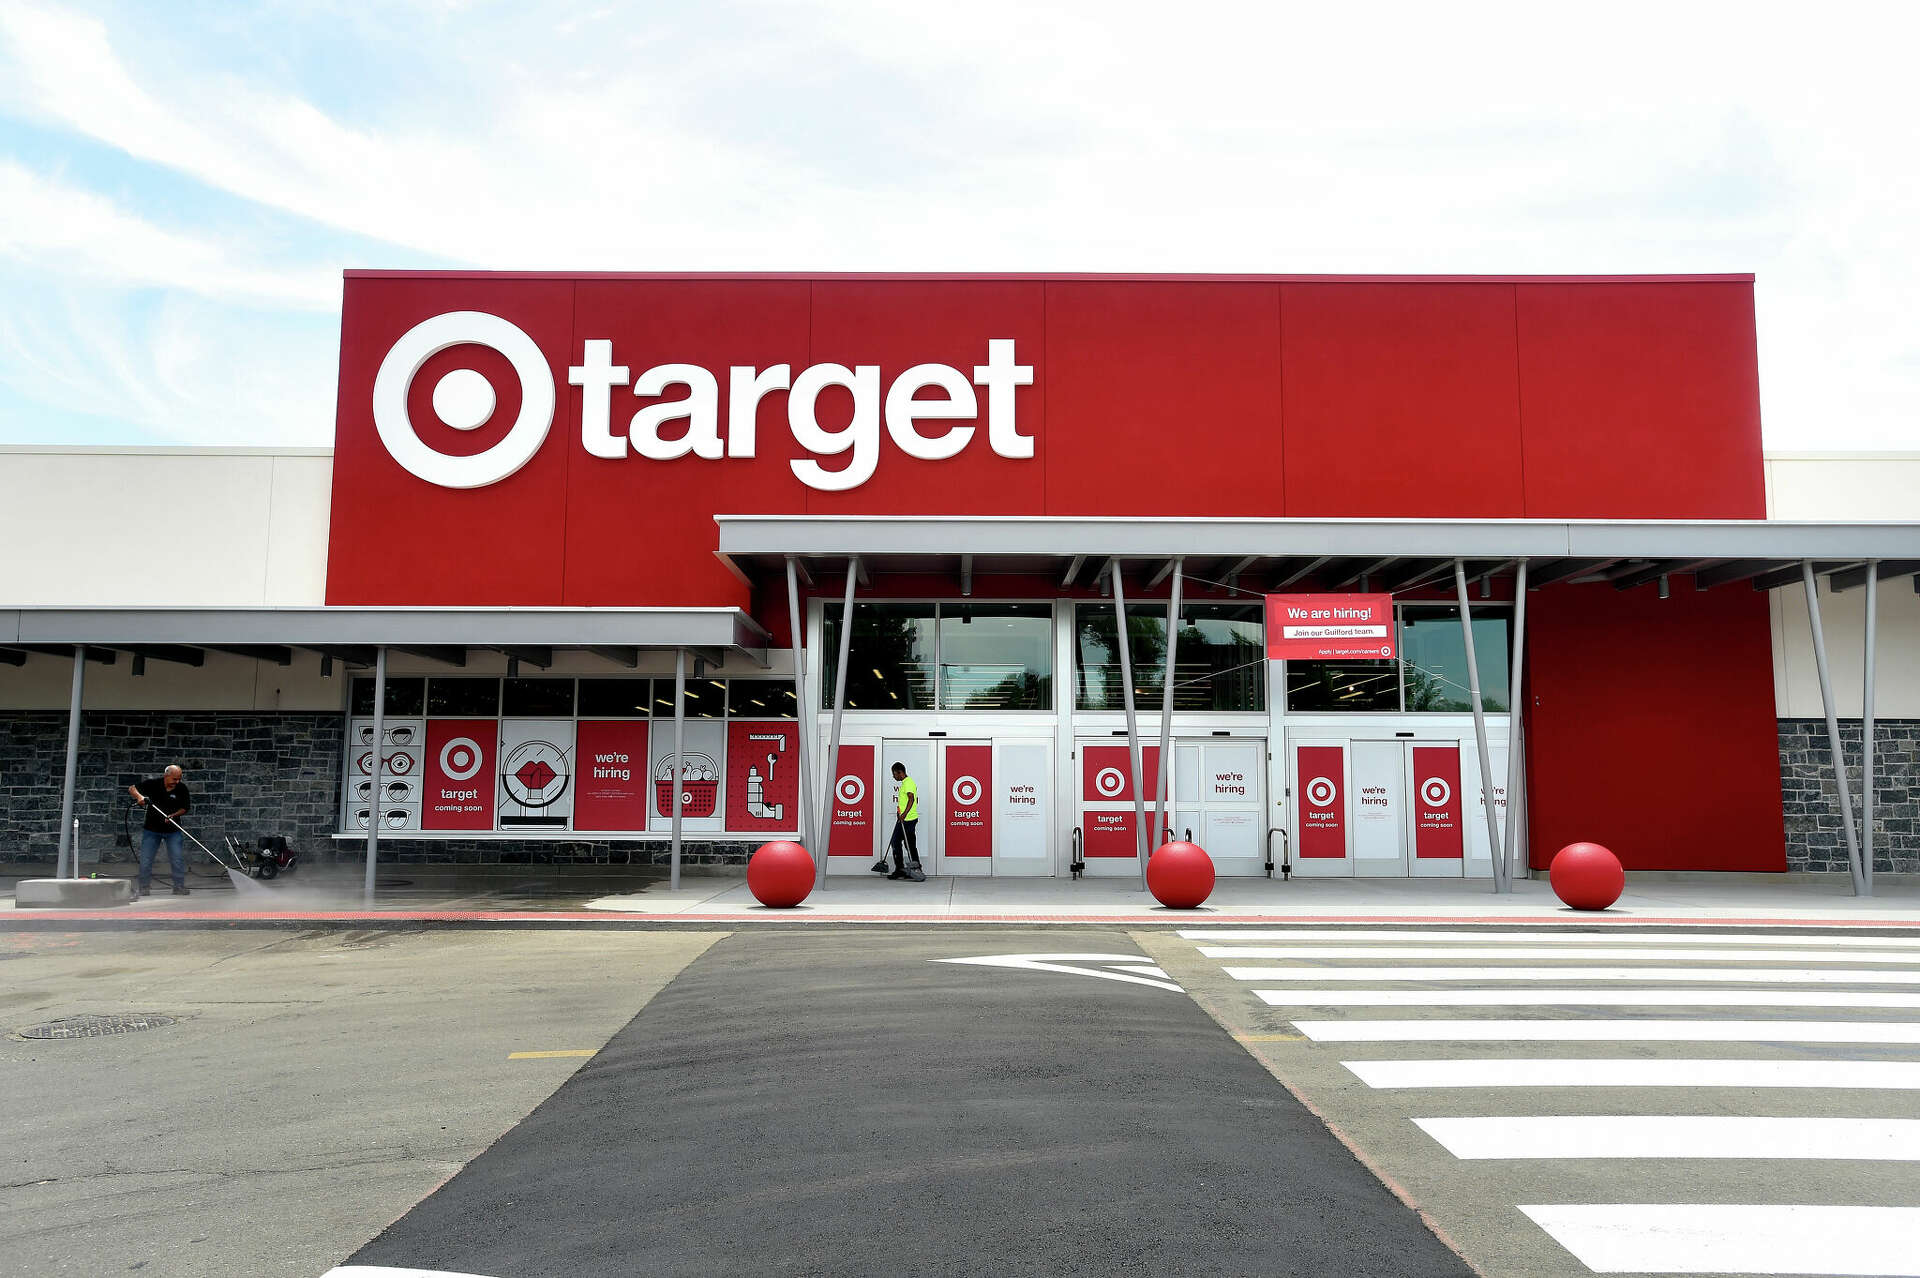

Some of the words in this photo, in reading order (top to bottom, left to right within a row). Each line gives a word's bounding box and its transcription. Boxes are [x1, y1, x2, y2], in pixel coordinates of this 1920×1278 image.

[568, 338, 1034, 491] target
[1287, 608, 1308, 619] We
[1311, 610, 1331, 619] are
[1333, 607, 1372, 621] hiring!
[1293, 629, 1309, 637] Join
[1324, 628, 1353, 636] Guilford
[595, 752, 629, 763] we're
[593, 767, 631, 781] hiring
[1215, 772, 1243, 781] we're
[1010, 785, 1034, 793] we're
[1215, 784, 1245, 796] hiring
[1362, 786, 1386, 794] we're
[441, 789, 478, 801] target
[1009, 795, 1036, 805] hiring
[1361, 797, 1388, 807] hiring
[434, 804, 462, 813] coming
[837, 809, 862, 818] target
[954, 810, 980, 819] target
[1309, 811, 1335, 820] target
[1424, 812, 1448, 820] target
[1097, 815, 1123, 824] target
